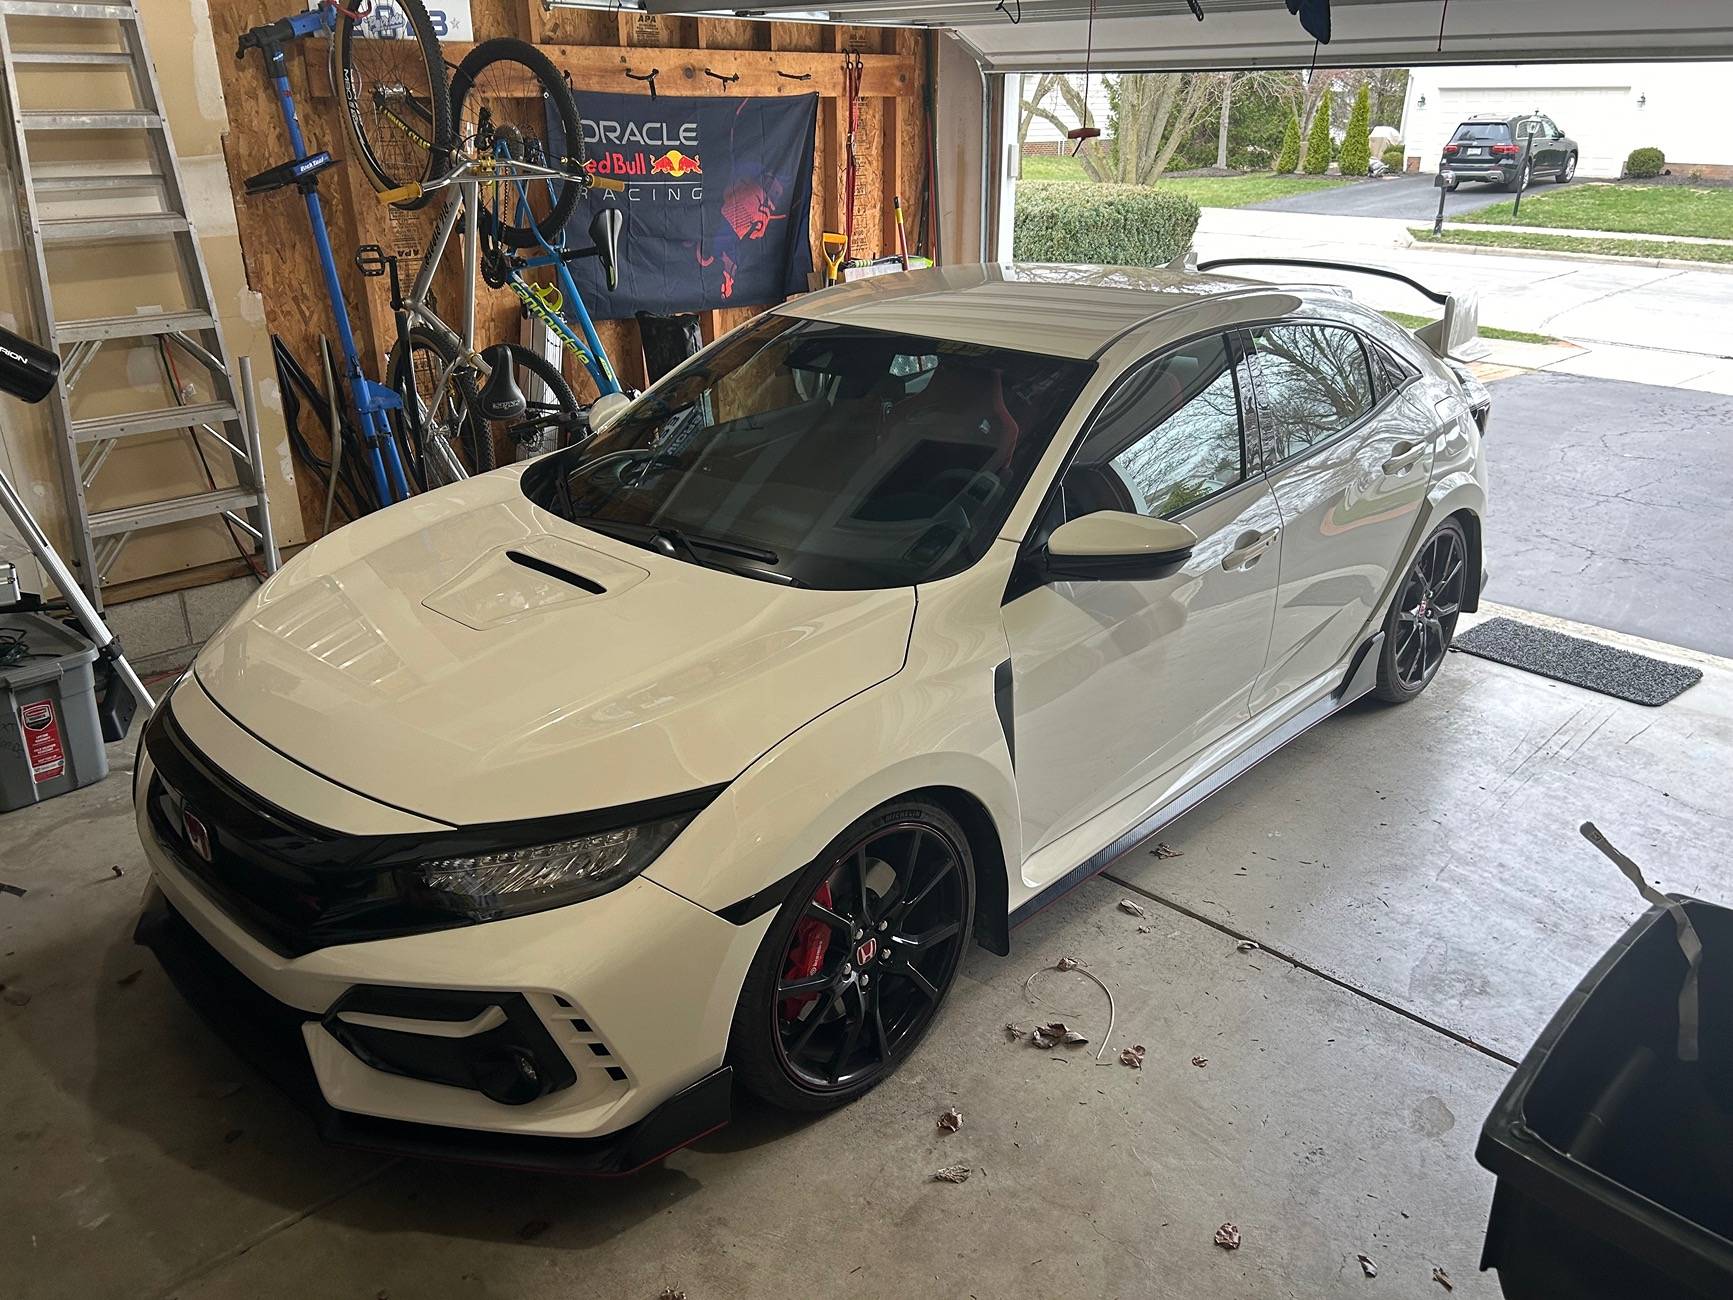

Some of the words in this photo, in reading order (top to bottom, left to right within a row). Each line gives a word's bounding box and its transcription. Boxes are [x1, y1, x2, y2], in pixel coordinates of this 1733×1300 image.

[637, 15, 657, 23] APA
[582, 151, 611, 175] ed
[612, 151, 647, 175] Bull
[580, 187, 703, 201] RACING
[510, 282, 590, 365] cannondale
